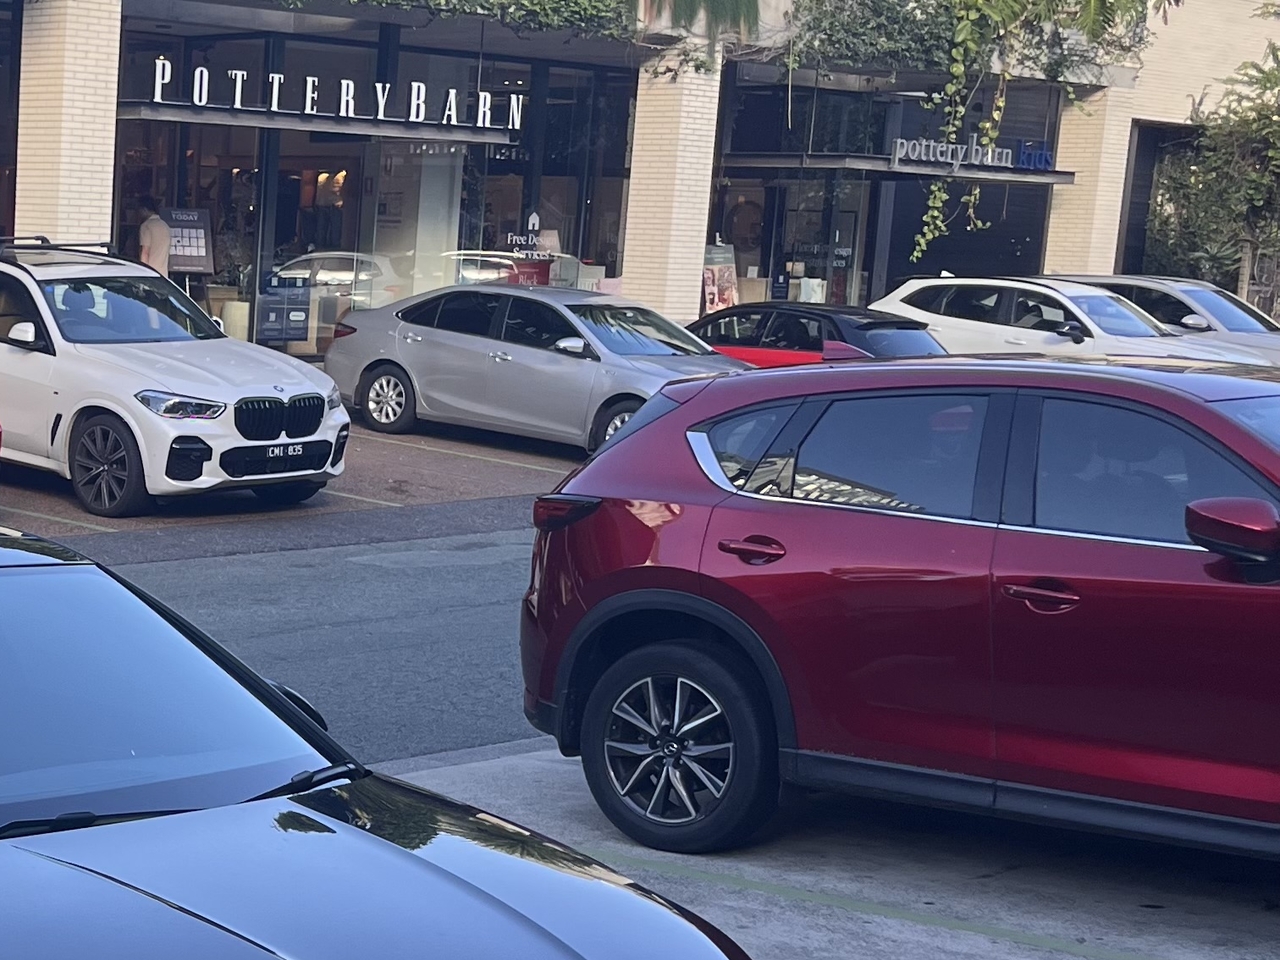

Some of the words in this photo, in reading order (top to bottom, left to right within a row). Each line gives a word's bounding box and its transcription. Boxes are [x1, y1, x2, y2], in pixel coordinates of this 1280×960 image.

[153, 58, 391, 120] POTTERY
[408, 81, 524, 130] BARN
[890, 138, 967, 173] pottery
[969, 133, 1014, 168] barn
[1017, 138, 1054, 171] kids
[171, 213, 198, 221] TODAY
[507, 232, 527, 245] Free
[513, 247, 550, 259] Services
